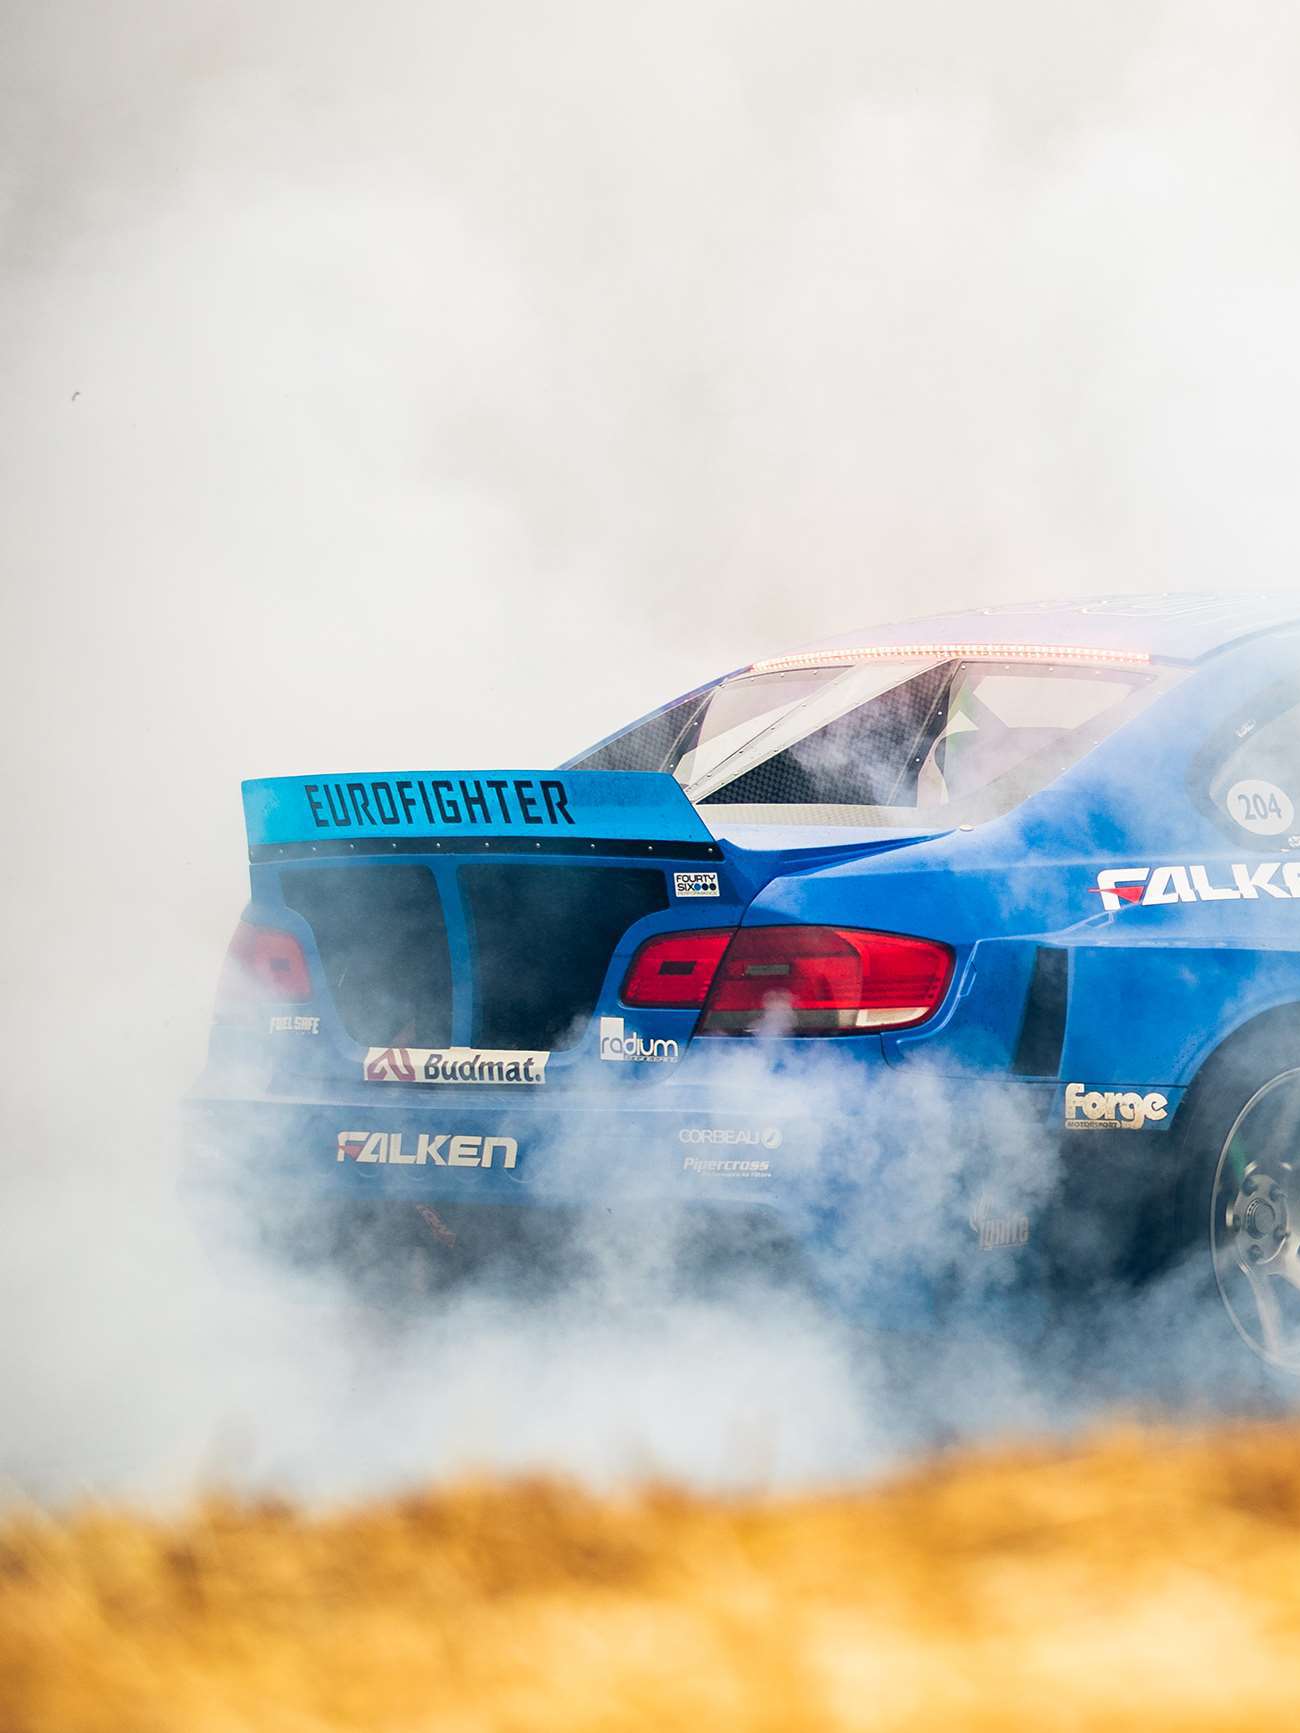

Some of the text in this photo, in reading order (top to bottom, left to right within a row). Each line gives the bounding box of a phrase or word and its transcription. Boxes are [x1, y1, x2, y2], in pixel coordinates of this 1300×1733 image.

[304, 780, 576, 828] EUROFIGHTER
[1238, 793, 1282, 820] 204
[676, 874, 716, 883] FOURTY
[677, 883, 696, 892] SIX
[600, 1032, 679, 1057] radium
[1065, 1082, 1168, 1130] forge
[679, 1128, 760, 1145] CORBEAU
[336, 1131, 519, 1170] FALKEN
[683, 1156, 769, 1173] Pipercross
